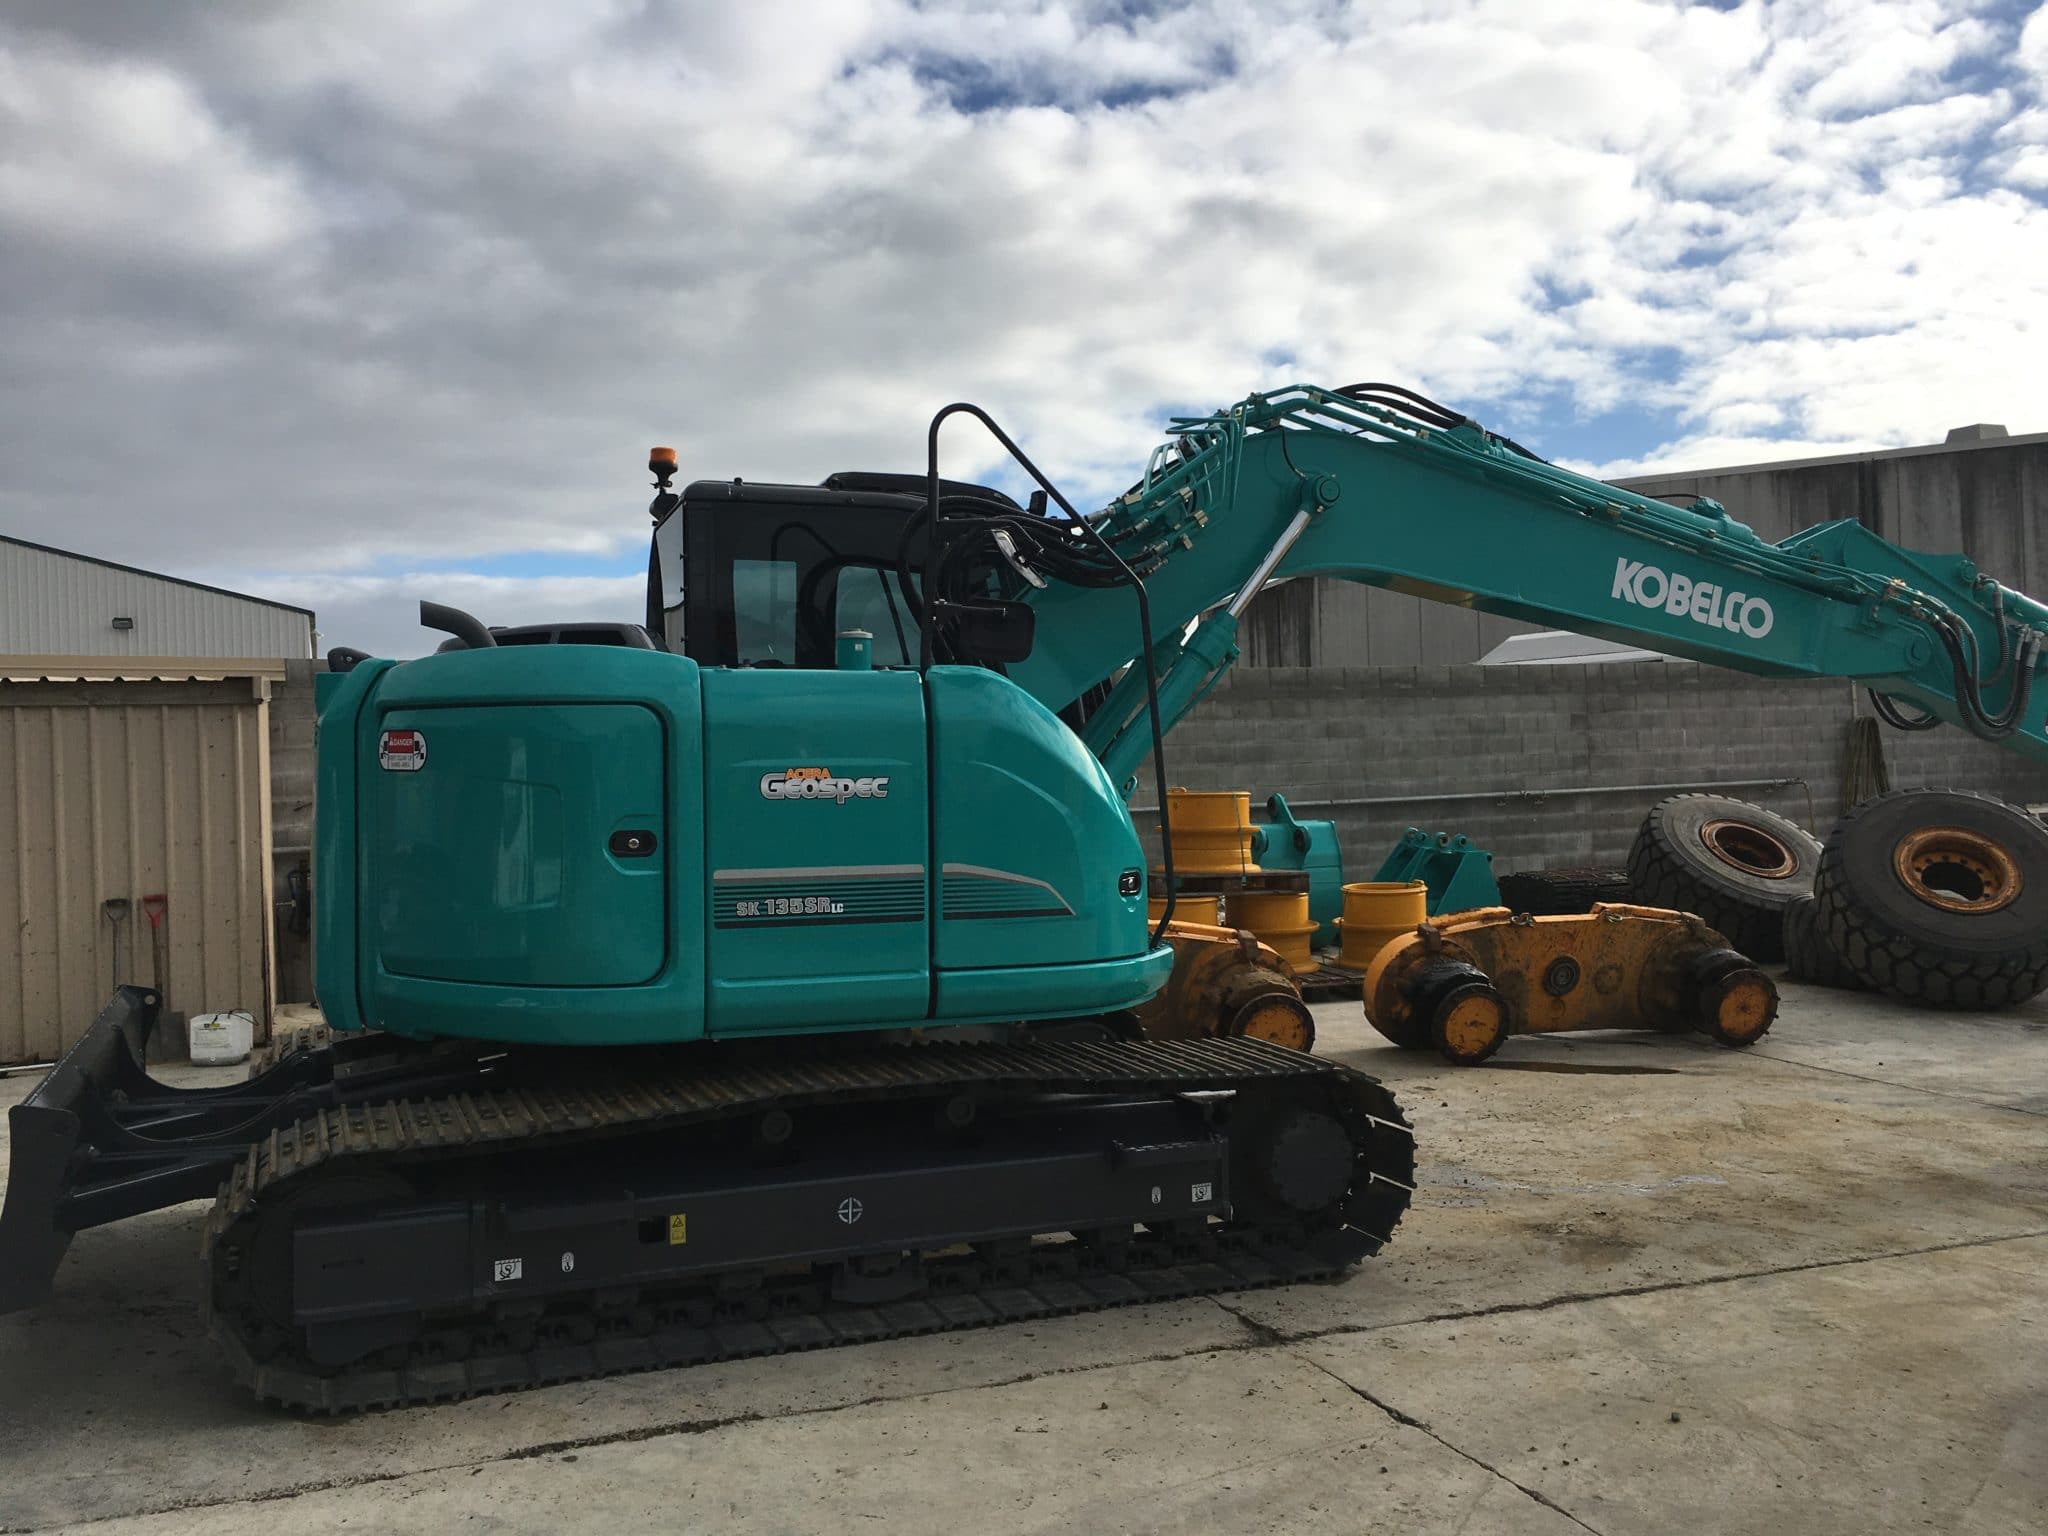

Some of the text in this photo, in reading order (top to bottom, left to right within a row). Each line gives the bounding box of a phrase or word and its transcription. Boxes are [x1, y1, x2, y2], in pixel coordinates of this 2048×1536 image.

[1611, 557, 1774, 639] KOBELCO
[393, 738, 413, 746] DANGER
[785, 768, 832, 780] ACERA
[761, 772, 889, 804] Geospec
[736, 901, 760, 916] SK
